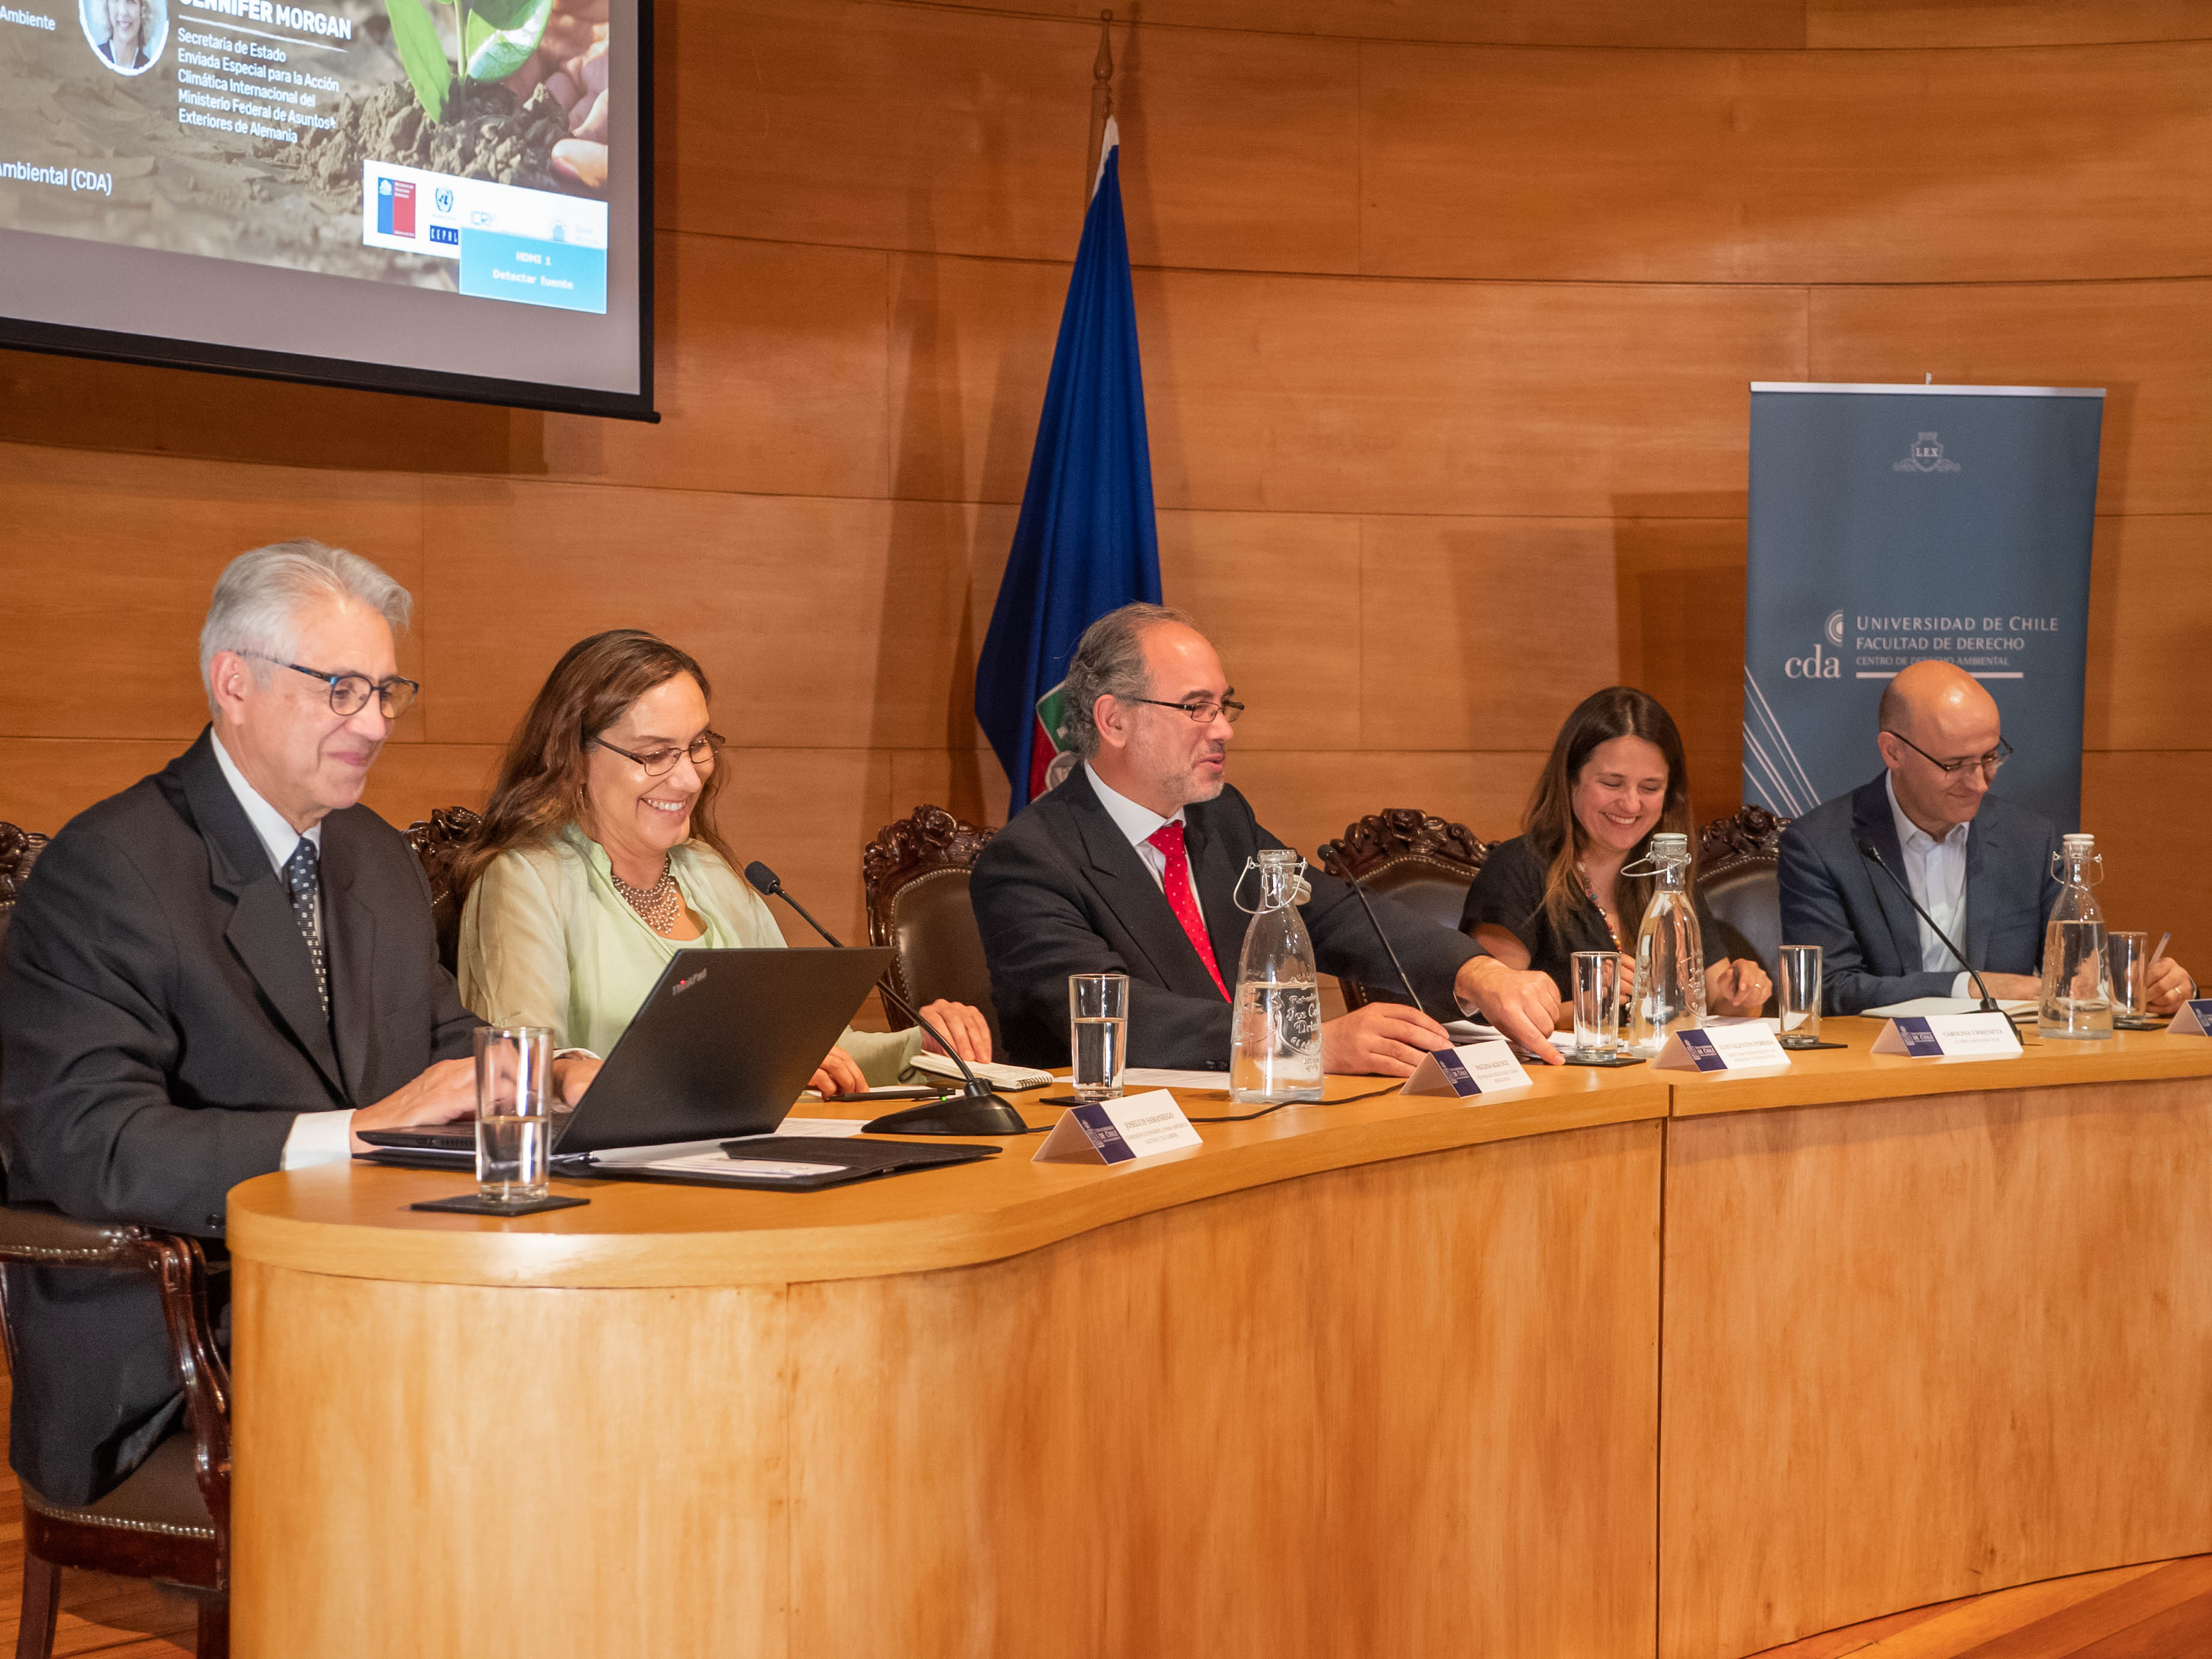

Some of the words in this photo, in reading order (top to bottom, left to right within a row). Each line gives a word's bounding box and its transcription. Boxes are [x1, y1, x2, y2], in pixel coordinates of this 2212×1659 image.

[0, 5, 56, 31] Ambiente
[181, 0, 273, 23] NNIFER
[275, 4, 352, 40] MORGAN
[177, 28, 233, 52] Secretaria
[234, 40, 249, 55] de
[249, 42, 287, 63] Estado
[177, 47, 221, 70] Enviada
[222, 57, 267, 79] Especial
[267, 68, 292, 84] para
[293, 71, 304, 85] la
[304, 73, 340, 92] Acción
[177, 69, 228, 91] Climática
[230, 79, 298, 104] Internacional
[299, 94, 316, 108] del
[178, 88, 231, 111] Ministerio
[231, 99, 272, 118] Federal
[272, 107, 287, 121] de
[287, 109, 331, 130] Asuntos
[178, 108, 233, 131] Exteriores
[234, 120, 249, 134] de
[249, 121, 299, 144] Alemania
[0, 160, 68, 186] mbiental
[70, 168, 113, 197] (CDA)
[515, 251, 542, 264] HDMI
[545, 256, 552, 266] 1
[492, 269, 537, 284] Detectar
[540, 275, 574, 290] fuente
[1856, 616, 1975, 631] UNIVERSIDAD
[1983, 617, 2003, 631] DE
[2009, 616, 2059, 632] CHILE
[1856, 637, 1929, 650] FACULTAD
[1932, 637, 1952, 650] DE
[1957, 637, 2025, 650] DERECHO
[1856, 656, 1893, 666] CENTRO
[1895, 656, 1908, 666] DE
[1957, 656, 2009, 667] AMBIENTAL
